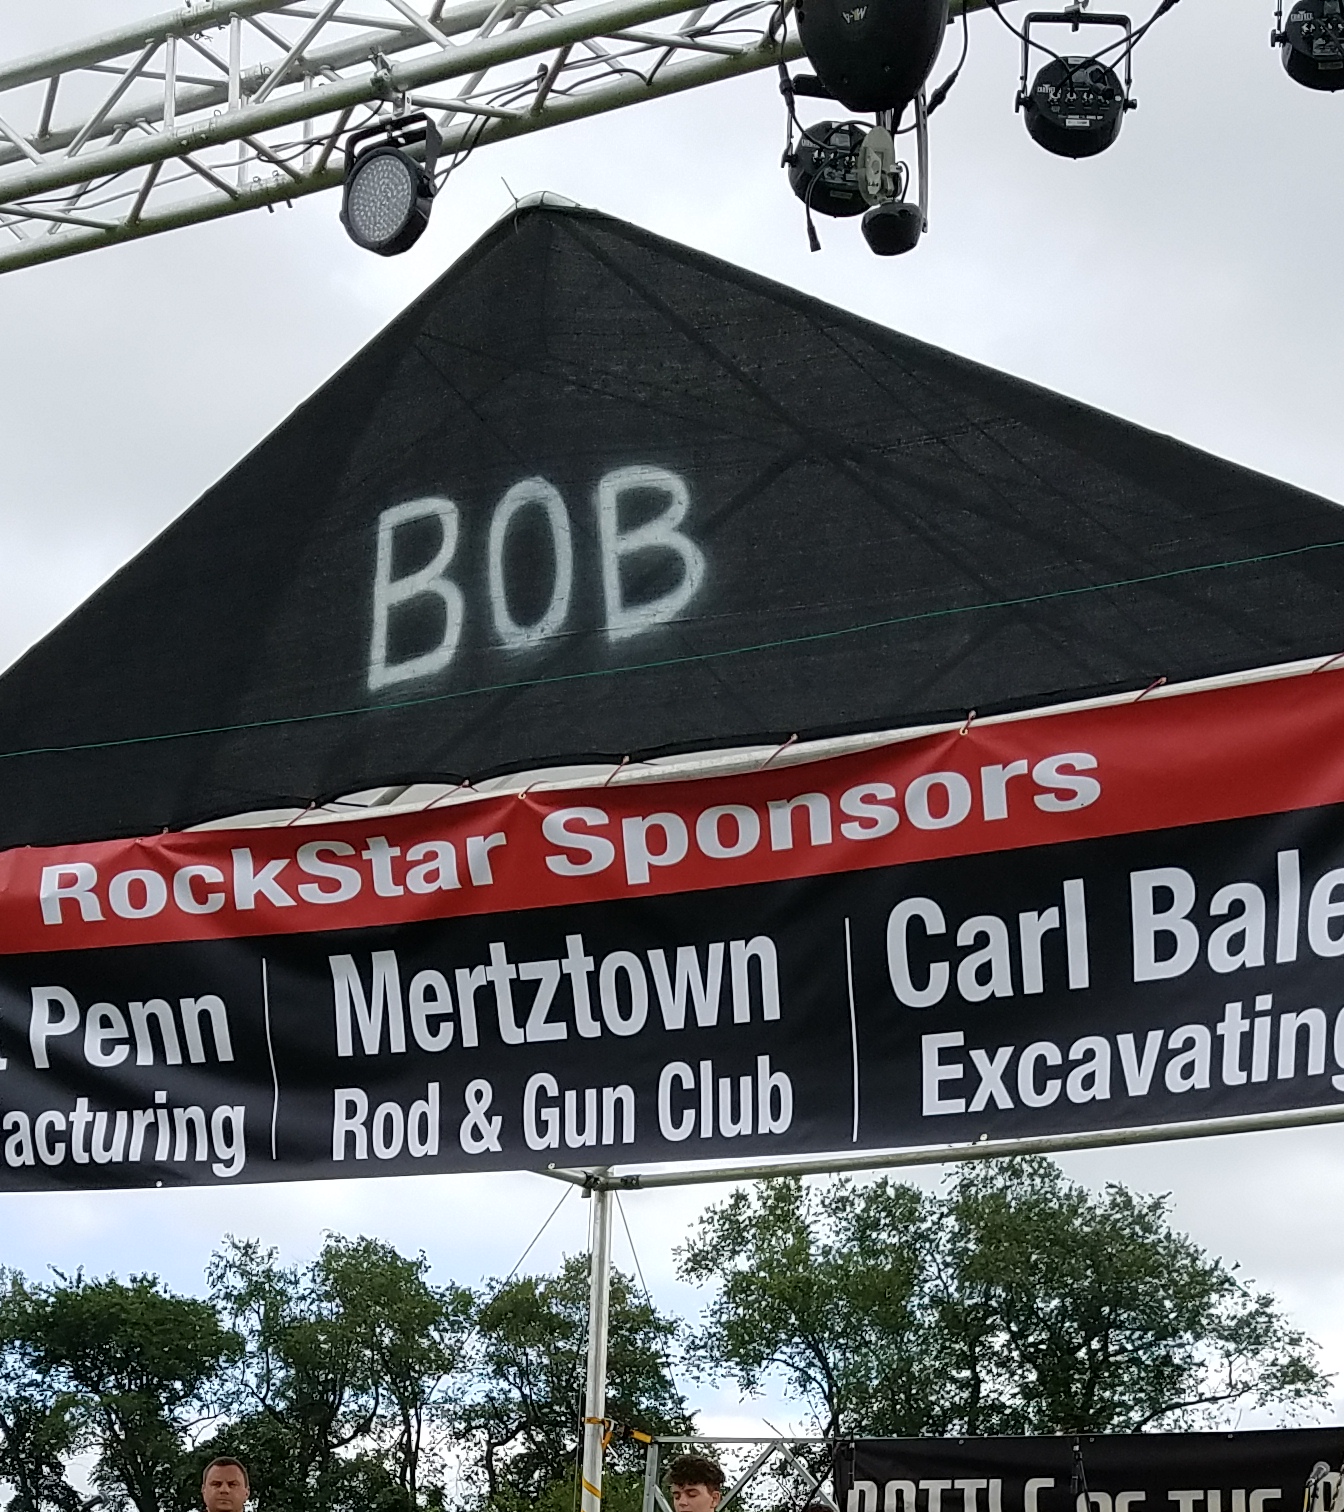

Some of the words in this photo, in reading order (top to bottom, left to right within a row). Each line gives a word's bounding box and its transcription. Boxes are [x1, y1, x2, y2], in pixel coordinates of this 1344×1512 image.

[367, 464, 707, 692] BOB
[39, 832, 507, 925] RockStar
[542, 751, 1102, 885] Sponsors
[329, 933, 782, 1058] Mertztown
[886, 878, 1088, 1009] Carl
[30, 985, 234, 1070] Penn
[333, 1082, 439, 1161] Rod
[459, 1078, 503, 1155] &
[524, 1073, 635, 1151] Gun
[657, 1054, 793, 1143] Club
